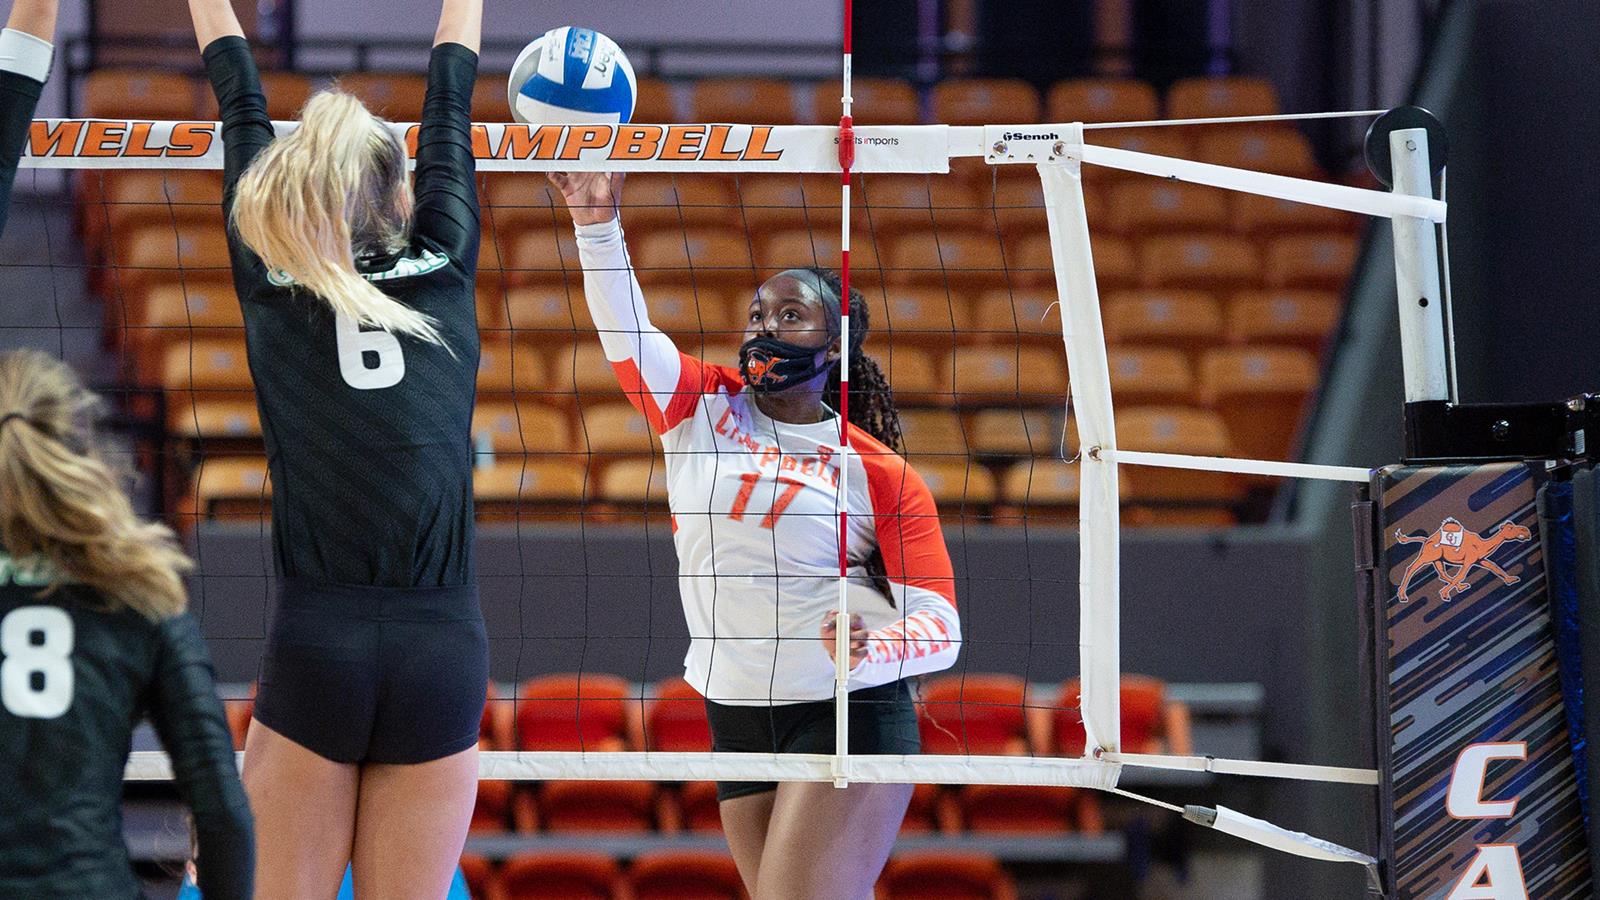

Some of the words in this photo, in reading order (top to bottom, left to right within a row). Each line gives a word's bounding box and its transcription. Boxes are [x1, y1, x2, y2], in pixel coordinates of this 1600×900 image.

[834, 137, 862, 145] sts
[864, 136, 899, 146] imports
[1013, 132, 1059, 141] Senoh
[336, 309, 406, 390] 6
[715, 406, 841, 487] CPBEL
[727, 471, 806, 529] 17
[1, 605, 75, 719] 8
